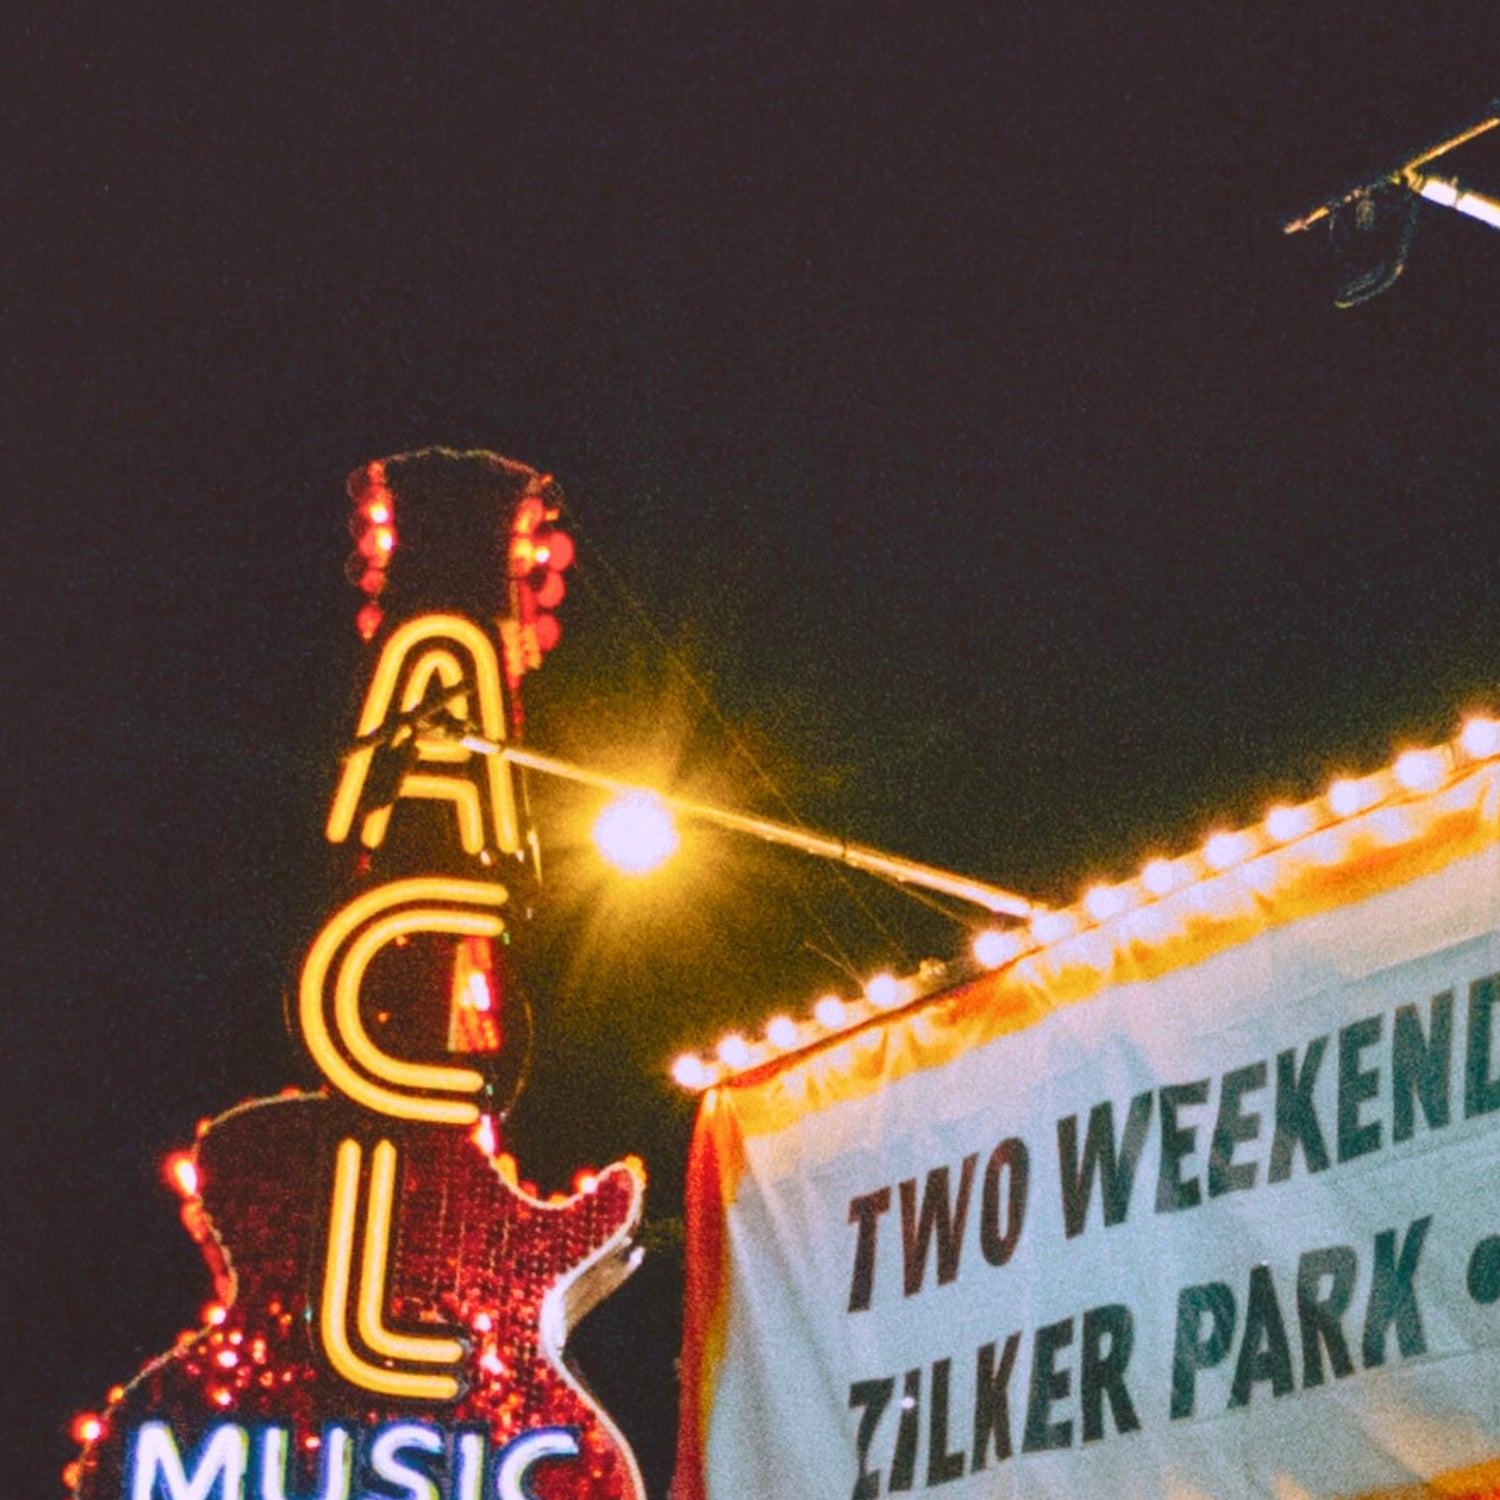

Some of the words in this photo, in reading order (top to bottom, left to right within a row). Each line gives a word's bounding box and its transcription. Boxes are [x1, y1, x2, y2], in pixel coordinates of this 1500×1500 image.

[299, 612, 520, 1399] ACL
[847, 1136, 1030, 1314] TWO
[1169, 1214, 1434, 1421] PARK
